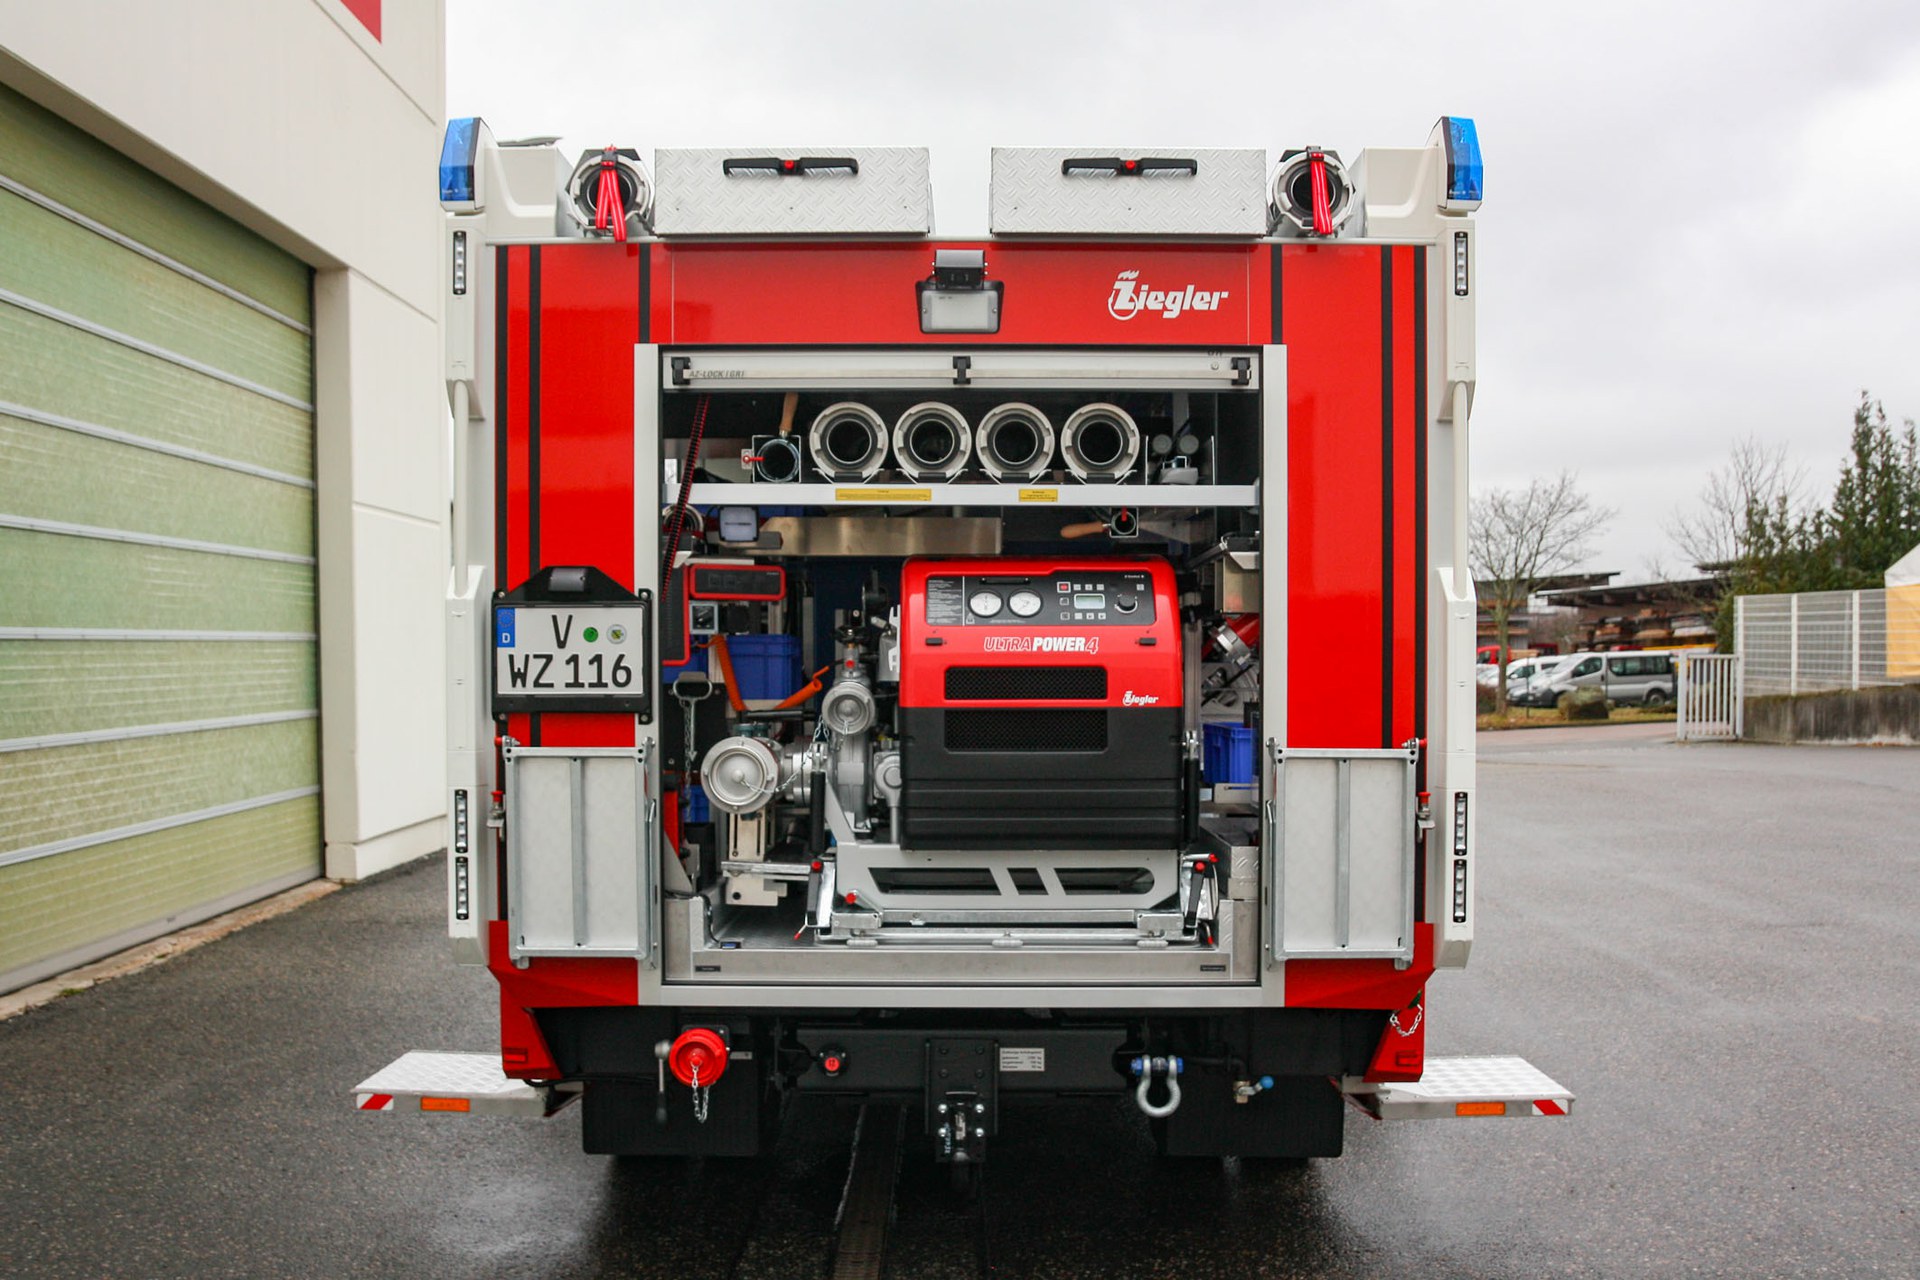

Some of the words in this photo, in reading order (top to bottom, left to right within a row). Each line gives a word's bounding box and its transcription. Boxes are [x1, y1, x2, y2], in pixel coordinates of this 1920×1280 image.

[1108, 270, 1229, 321] Ziegler
[502, 633, 511, 643] D
[552, 614, 573, 649] V
[508, 654, 554, 688] WZ
[565, 654, 632, 688] 116
[1122, 690, 1159, 707] Ziegler
